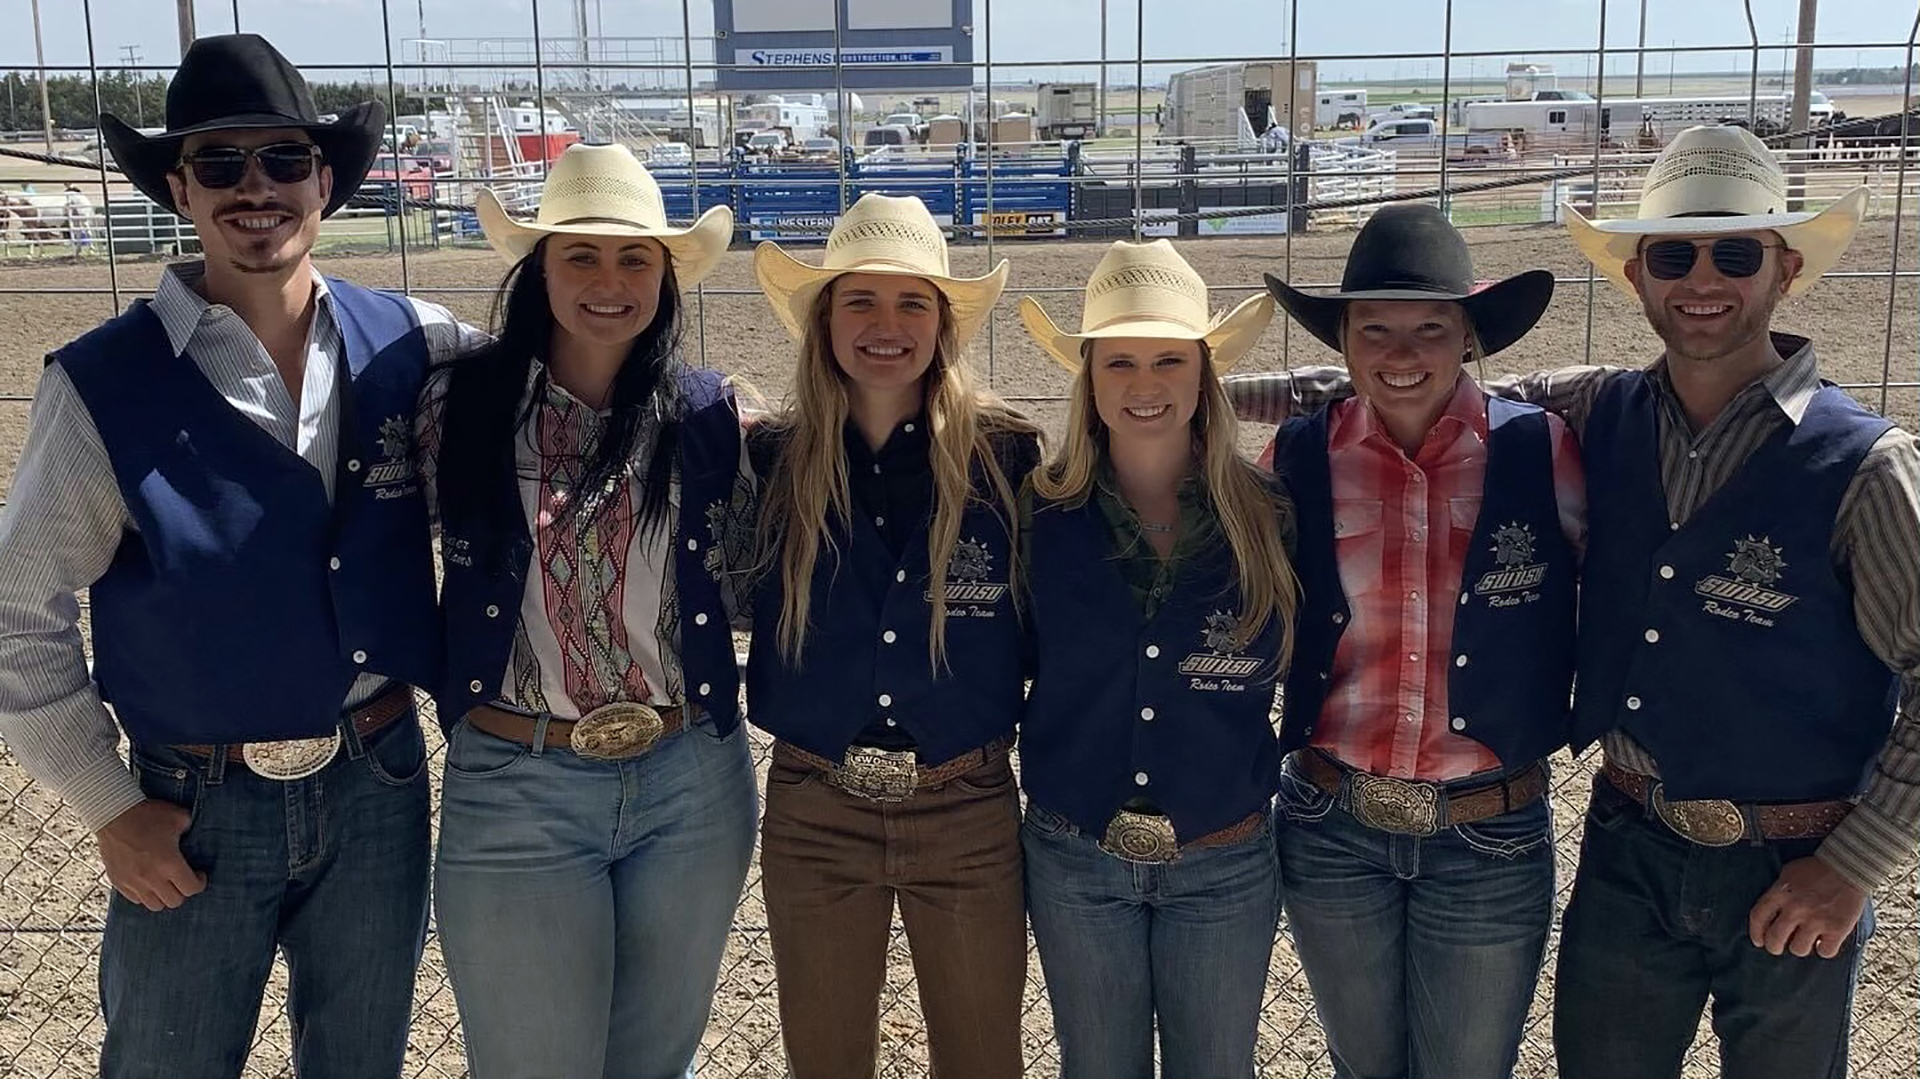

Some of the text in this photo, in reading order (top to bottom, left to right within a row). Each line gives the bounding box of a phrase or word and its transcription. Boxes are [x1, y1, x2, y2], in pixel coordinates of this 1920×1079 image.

[752, 51, 832, 65] STEPHENS
[1489, 595, 1521, 608] Rodeo
[943, 605, 996, 617] odeo Team
[1702, 600, 1775, 627] Rodeo Team
[1190, 678, 1245, 692] Rodeo Team
